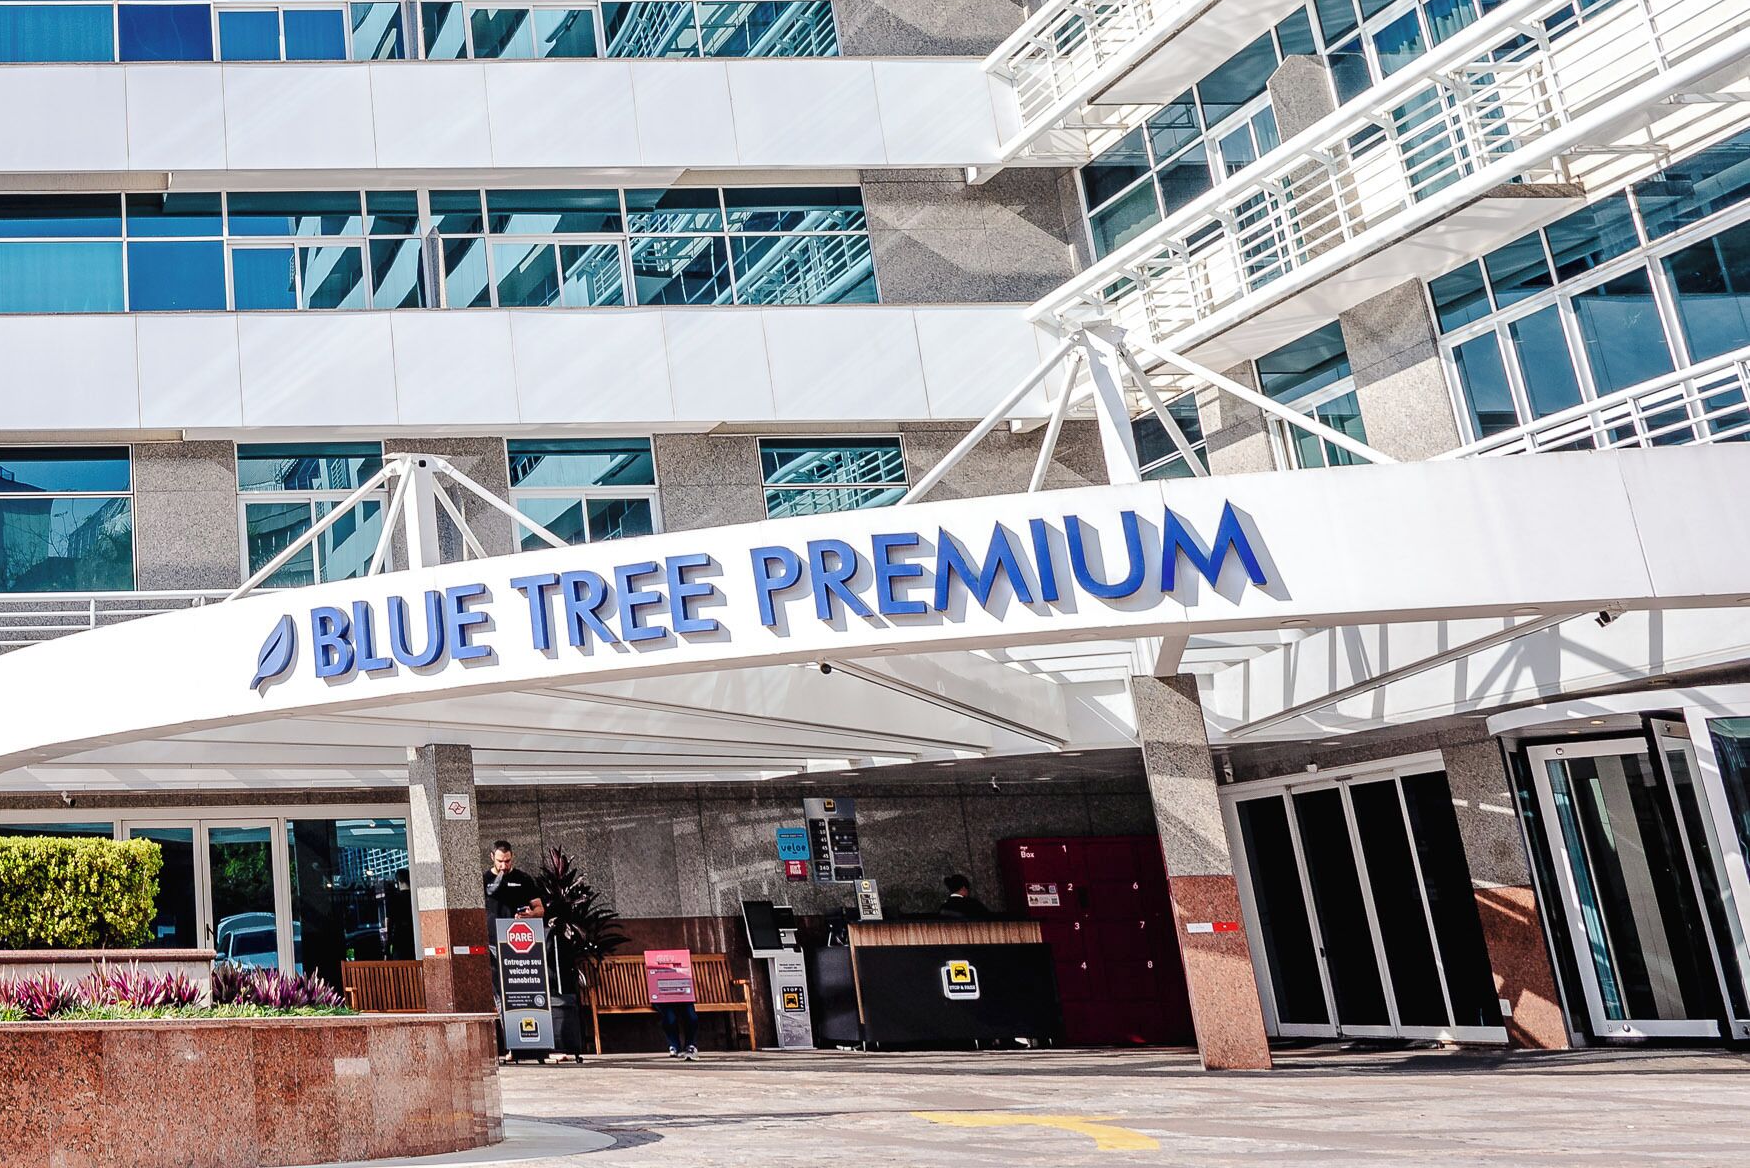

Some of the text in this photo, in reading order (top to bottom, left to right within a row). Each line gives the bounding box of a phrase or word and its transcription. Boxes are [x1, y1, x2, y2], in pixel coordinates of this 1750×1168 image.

[312, 500, 1268, 678] BLUE TREE PREMIUM
[780, 843, 806, 852] veloe
[1067, 883, 1073, 891] 2
[1132, 882, 1139, 890] 6
[1074, 922, 1080, 930] 3
[1139, 921, 1145, 929] 7
[509, 932, 533, 942] PARE
[503, 958, 530, 966] Entregue
[1081, 961, 1087, 969] 4
[1147, 960, 1153, 968] 8
